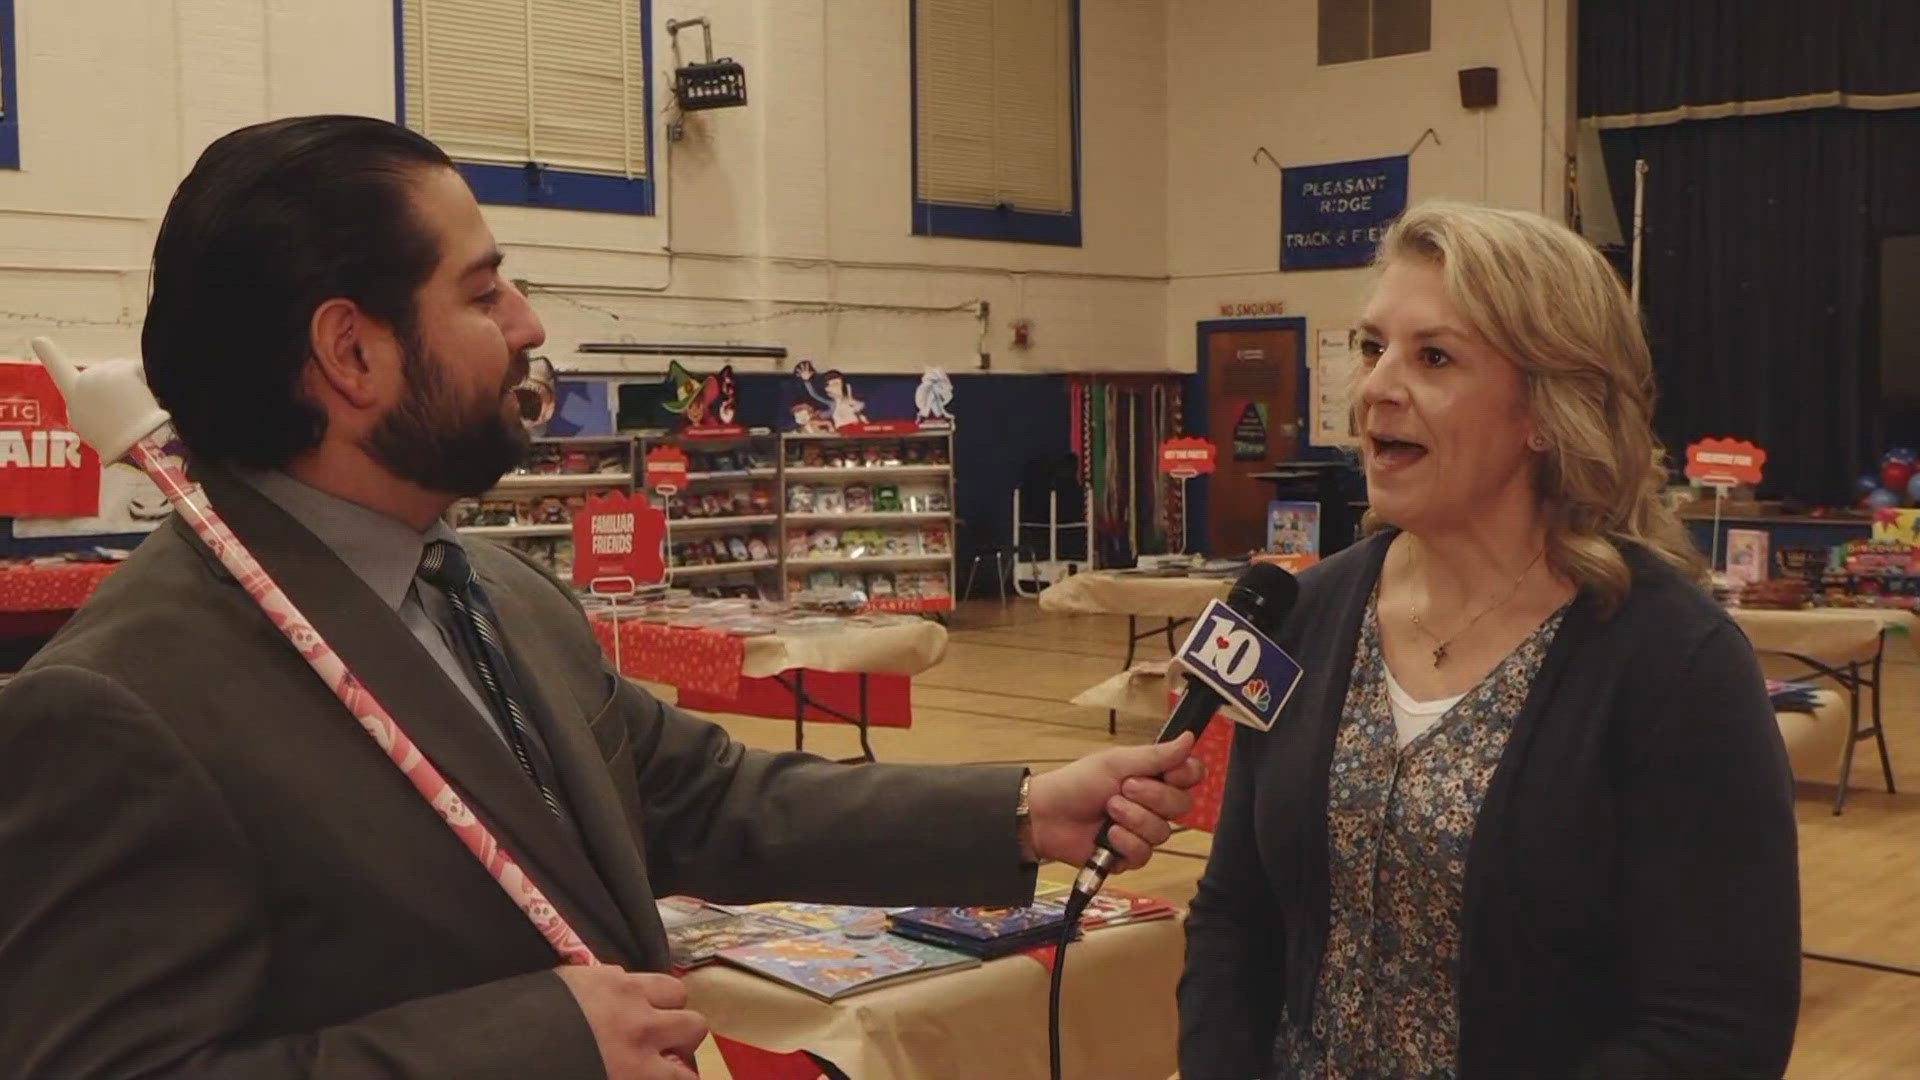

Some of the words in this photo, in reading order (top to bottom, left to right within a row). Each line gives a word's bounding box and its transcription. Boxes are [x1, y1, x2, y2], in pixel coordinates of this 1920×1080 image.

[1302, 175, 1386, 197] PLEASANT
[1320, 196, 1372, 213] RIDGE
[1284, 230, 1330, 248] TRACK
[1220, 304, 1234, 316] NO
[1236, 302, 1284, 316] SMOKING
[591, 513, 635, 535] FAMILIAR
[592, 534, 633, 555] FRIENDS
[1188, 614, 1262, 686] 10
